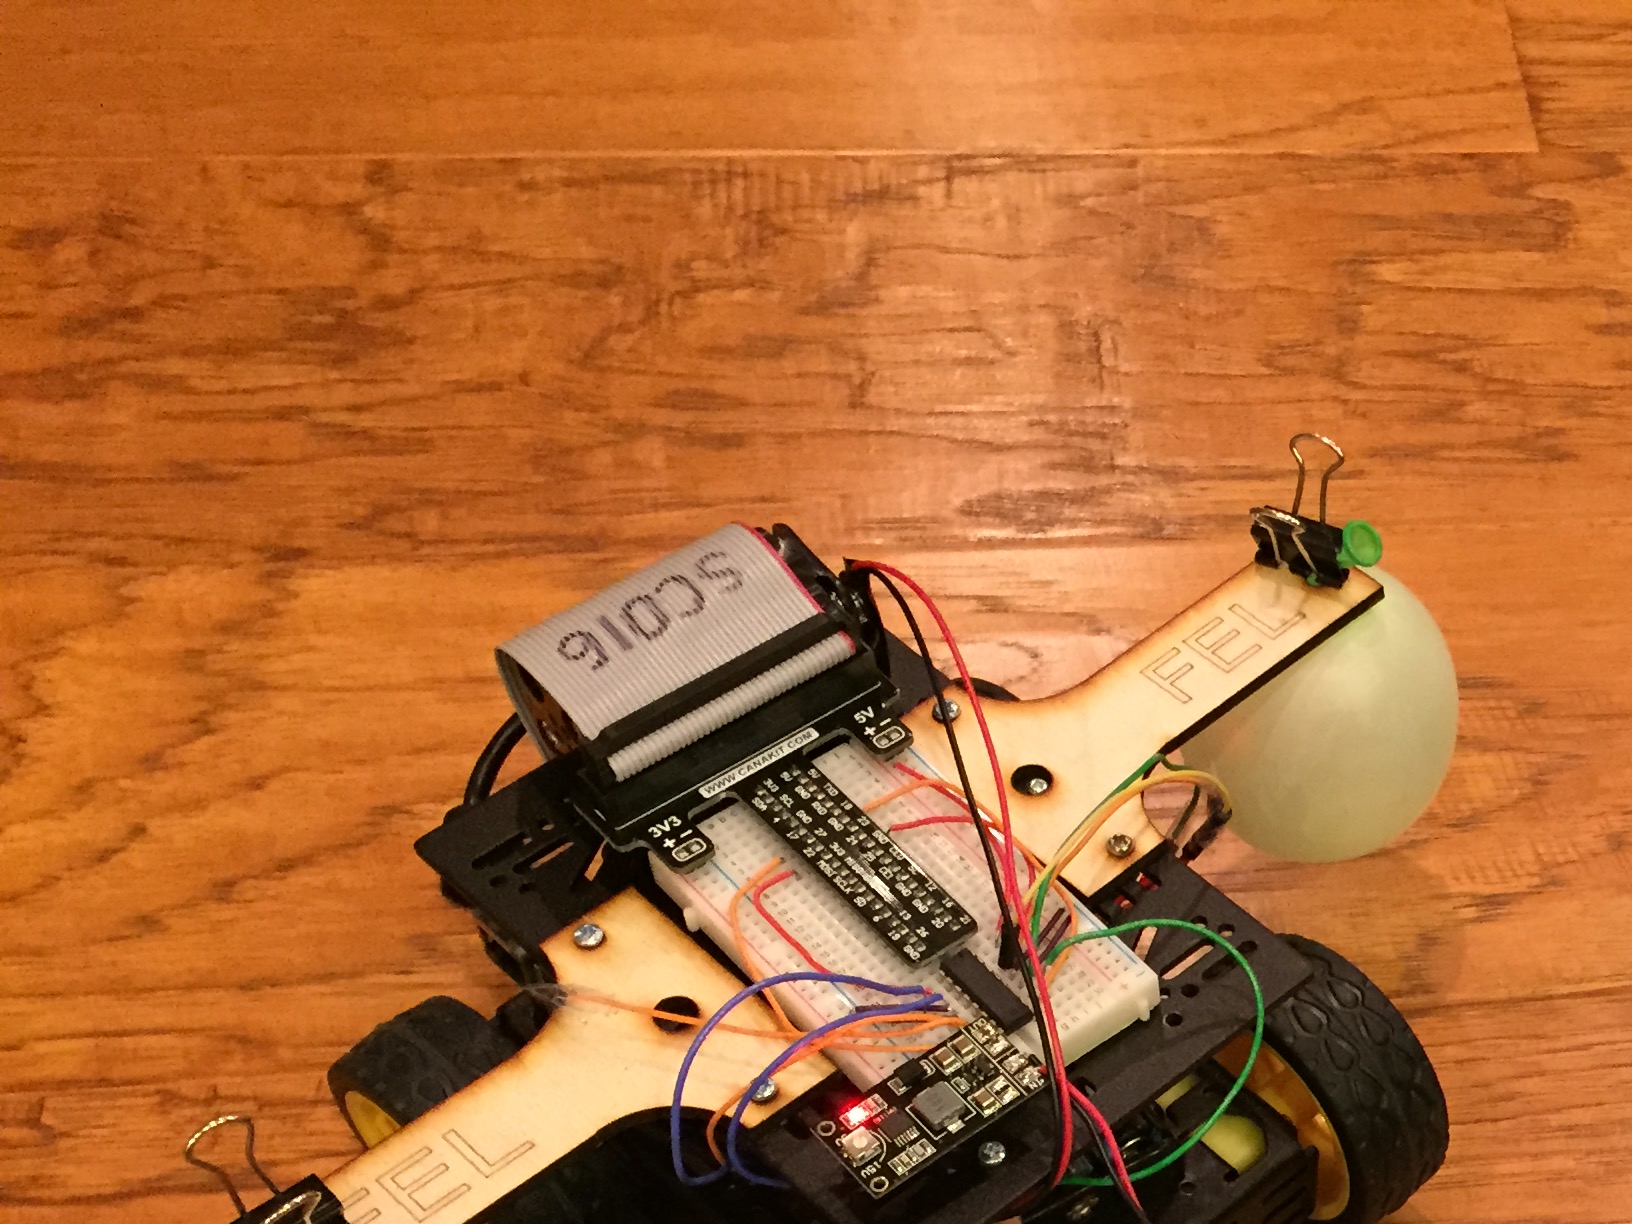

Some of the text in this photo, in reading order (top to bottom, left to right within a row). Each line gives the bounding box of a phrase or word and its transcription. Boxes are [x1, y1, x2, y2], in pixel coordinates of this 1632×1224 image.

[556, 548, 745, 671] SC016
[1139, 602, 1307, 704] FEL
[853, 705, 877, 727] 5V
[647, 815, 684, 840] 3V3
